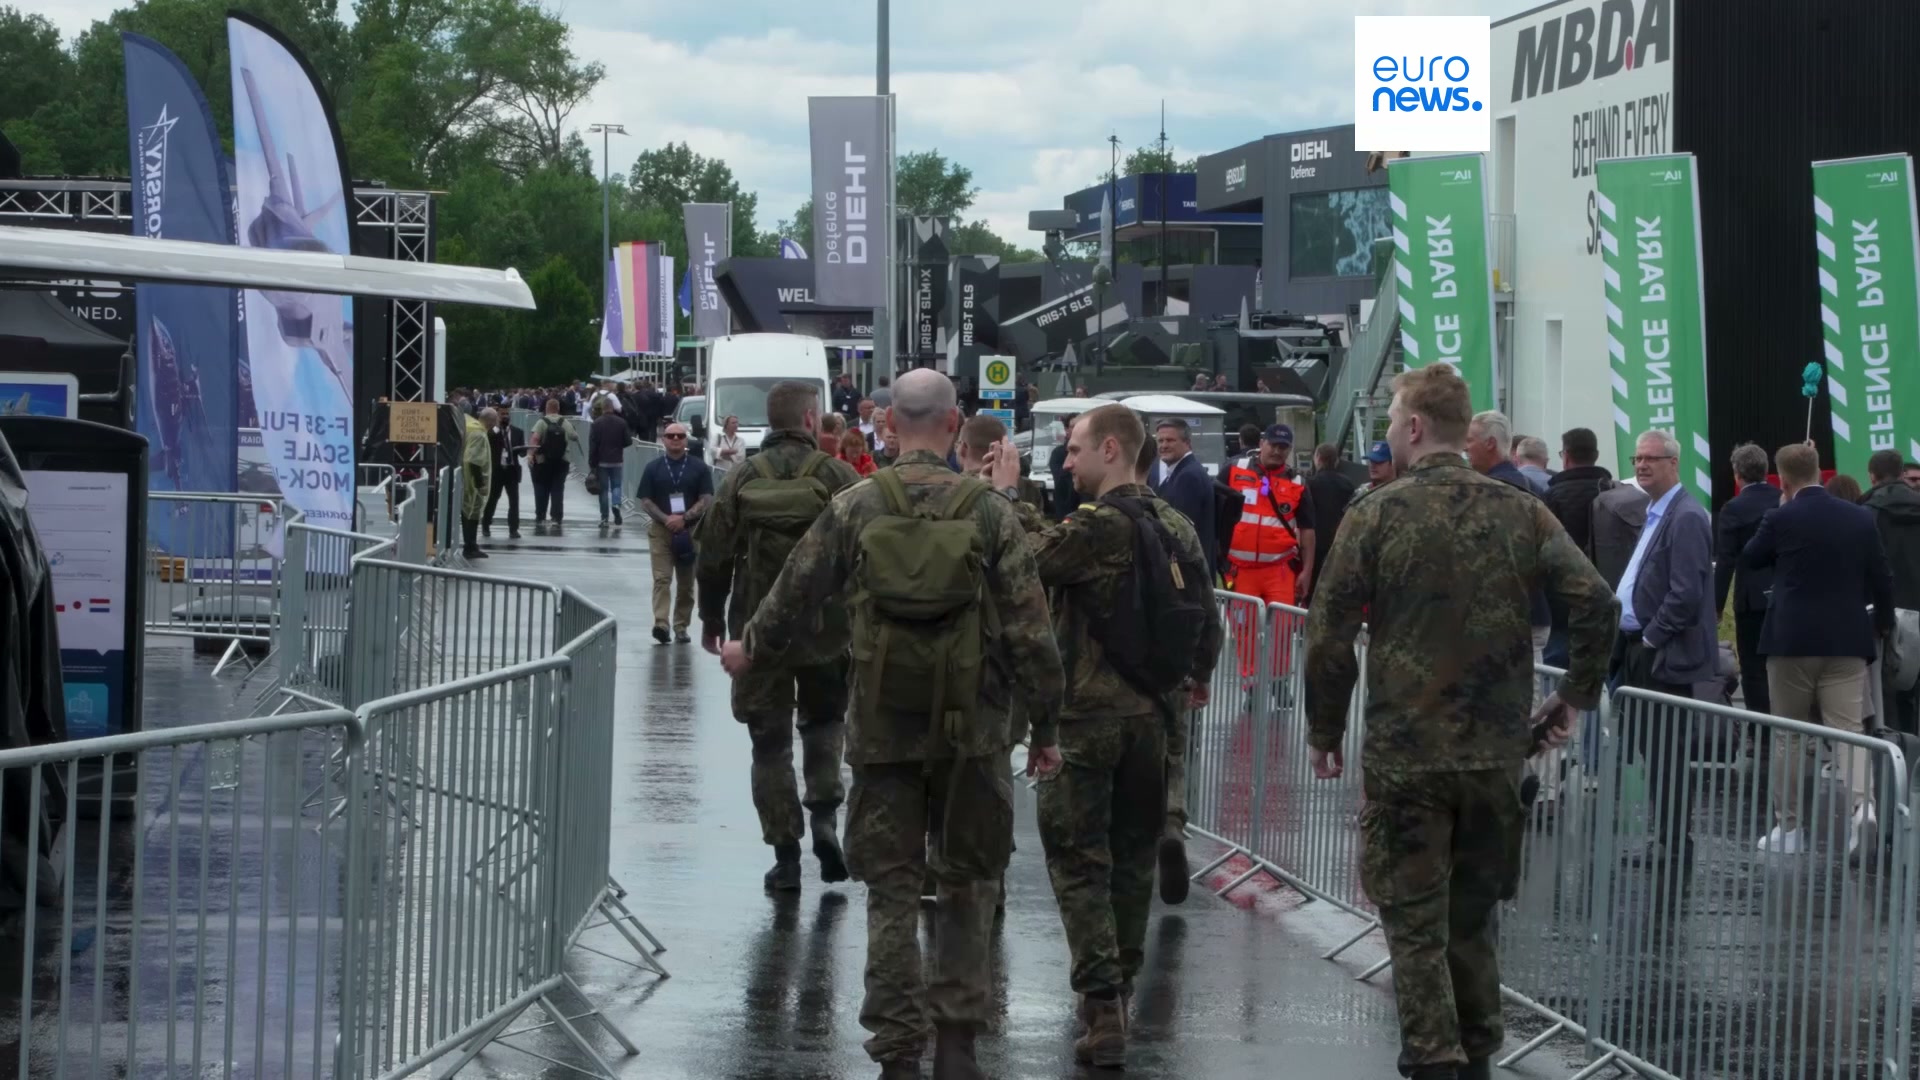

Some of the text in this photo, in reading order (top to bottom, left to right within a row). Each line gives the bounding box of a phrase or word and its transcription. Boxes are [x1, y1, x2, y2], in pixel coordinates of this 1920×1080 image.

[1510, 0, 1670, 103] MBDA
[1291, 140, 1332, 162] DIEHL
[1572, 91, 1670, 179] BEHIND EVERY
[1290, 164, 1316, 179] Defence
[777, 288, 814, 303] WEL
[1036, 296, 1093, 327] IRIS-T SLS
[921, 312, 932, 349] IRIS-T
[963, 284, 974, 347] IRIS-T SLS
